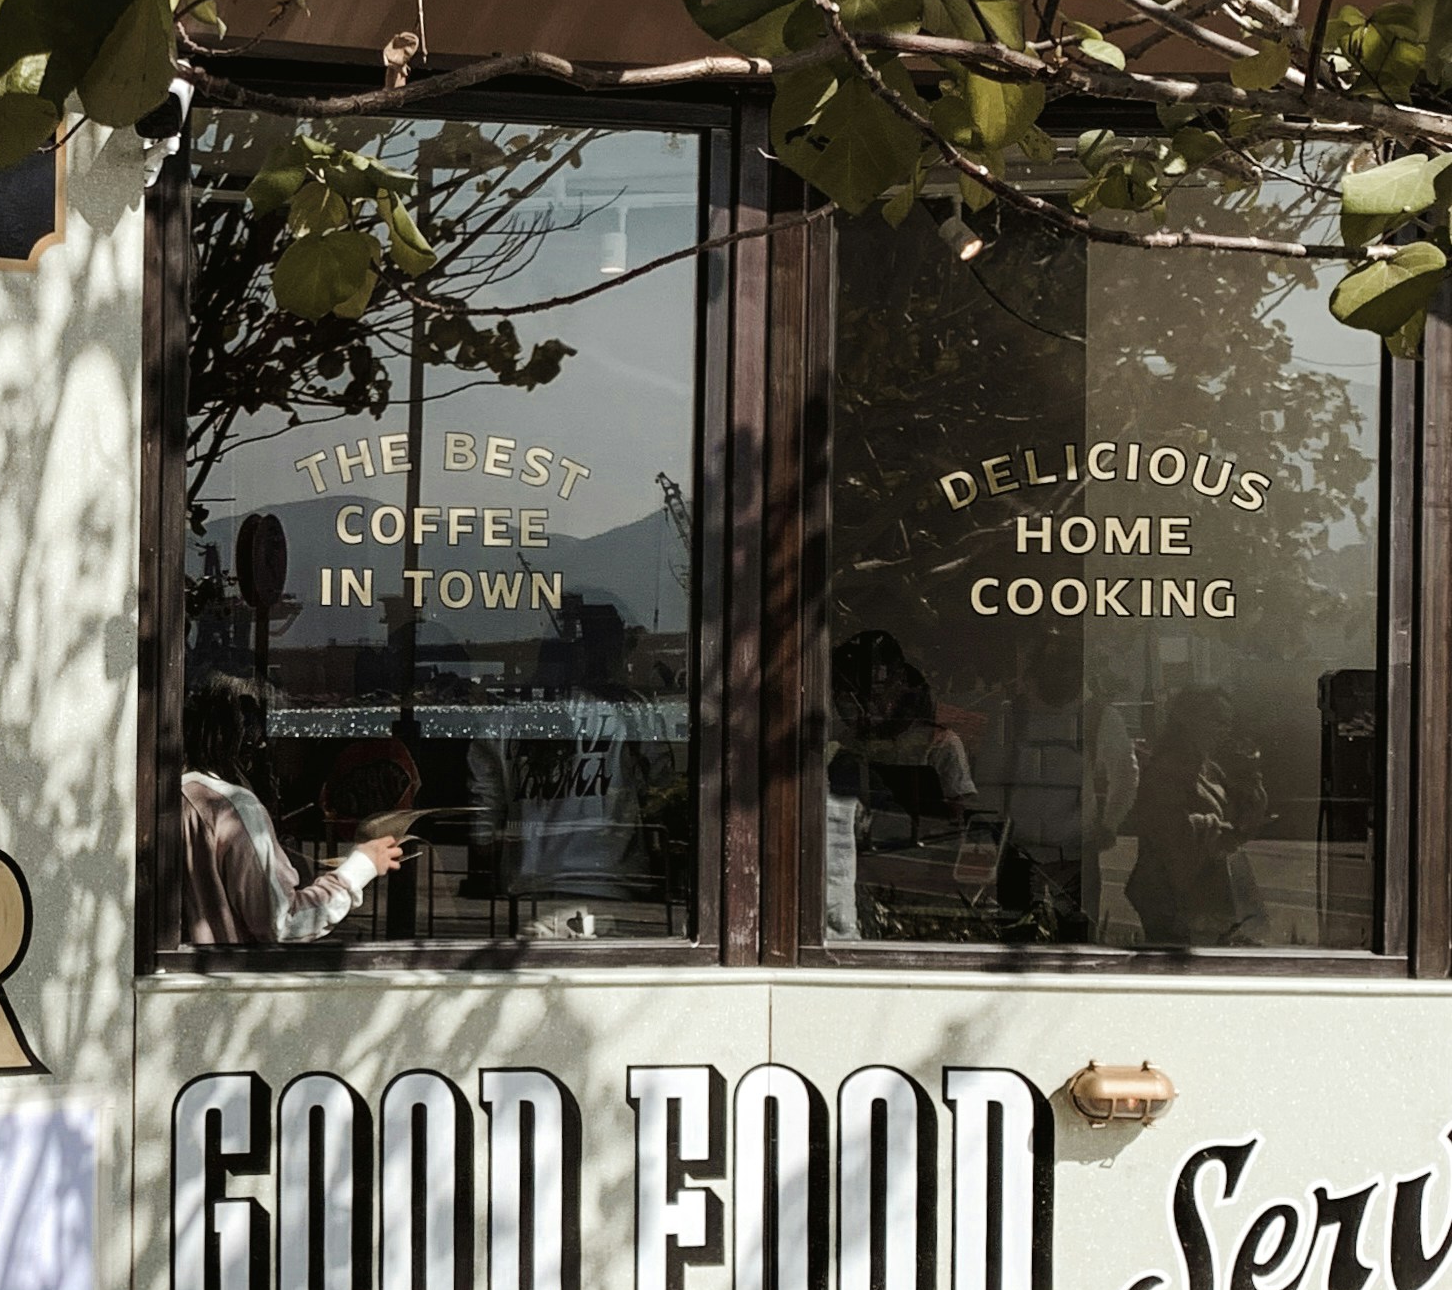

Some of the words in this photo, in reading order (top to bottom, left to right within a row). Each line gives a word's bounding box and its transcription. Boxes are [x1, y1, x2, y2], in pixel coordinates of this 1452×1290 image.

[294, 432, 413, 495] THE
[443, 431, 592, 501] BEST
[938, 441, 1273, 512] DELICIOUS
[335, 504, 550, 548] COFFEE
[1015, 515, 1193, 556] HOME
[320, 567, 374, 608] IN
[402, 569, 565, 611] TOWN
[970, 576, 1237, 619] COOKING
